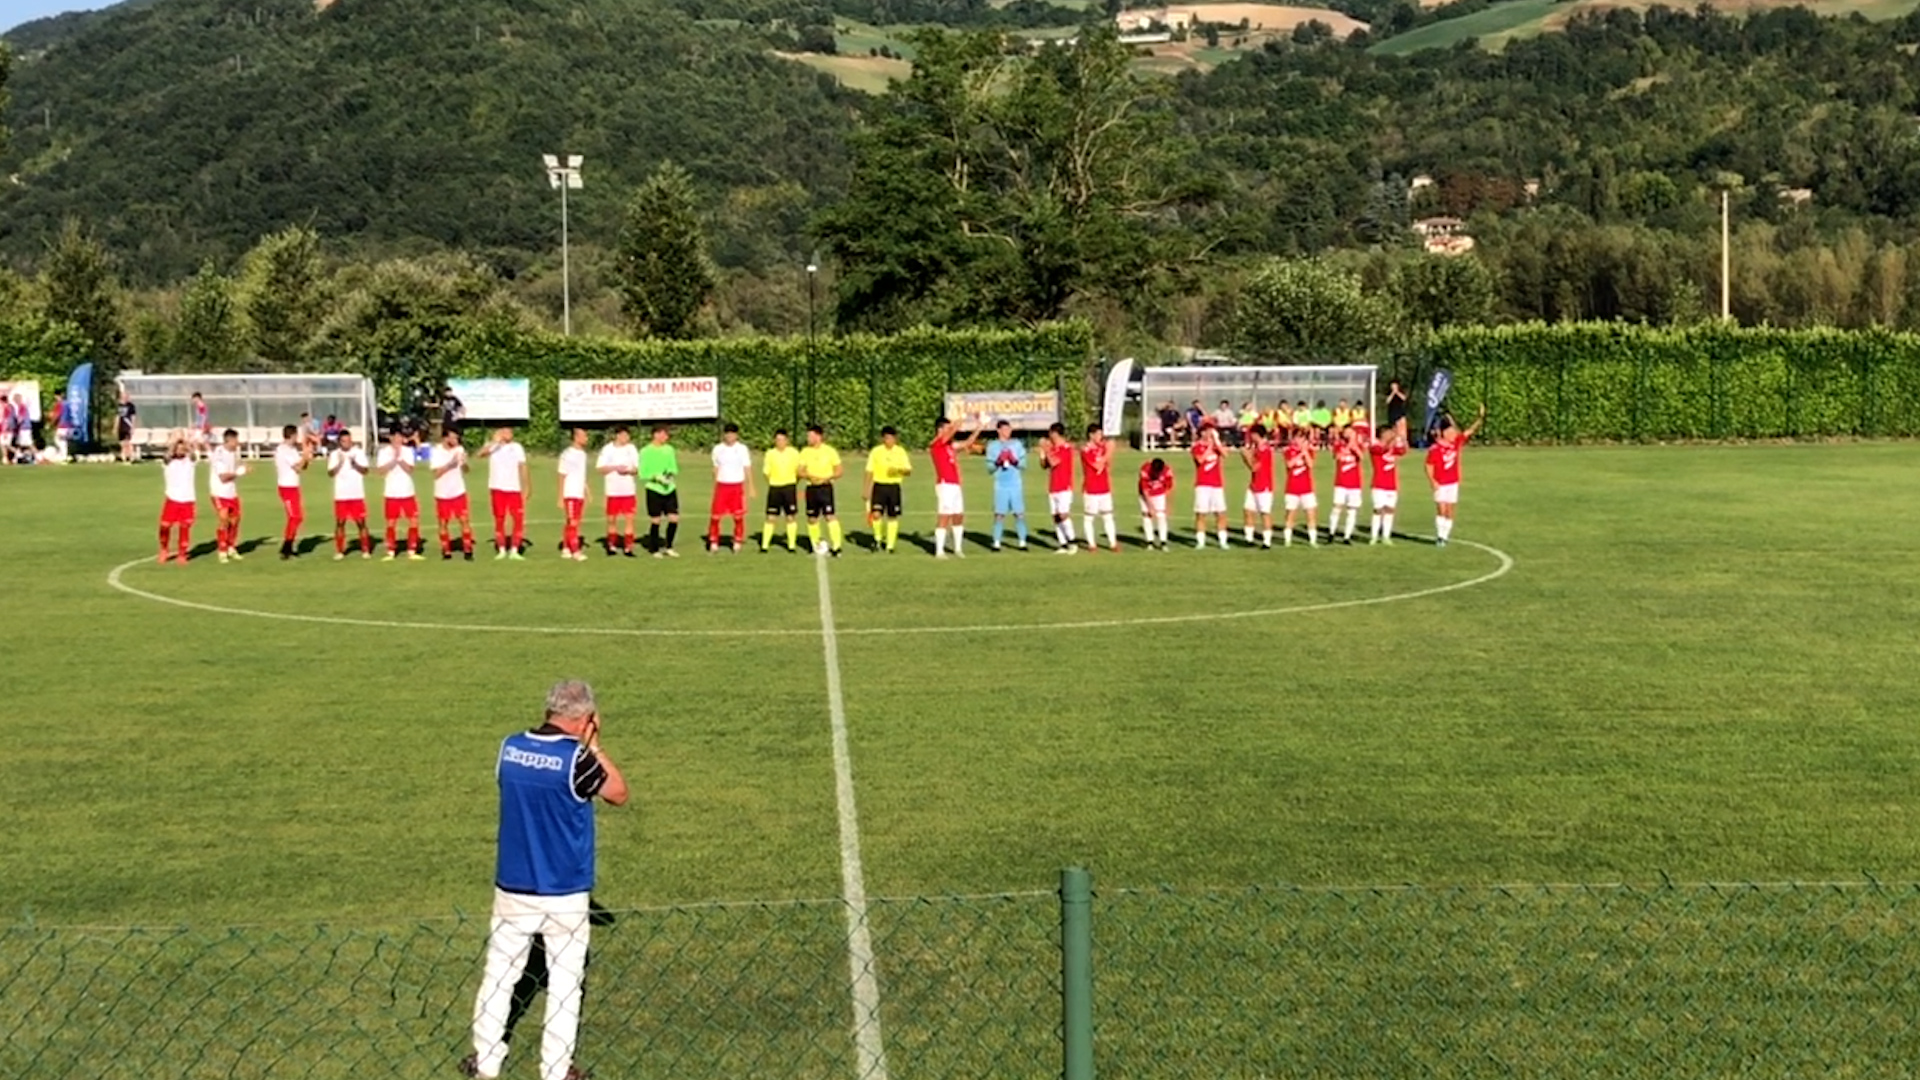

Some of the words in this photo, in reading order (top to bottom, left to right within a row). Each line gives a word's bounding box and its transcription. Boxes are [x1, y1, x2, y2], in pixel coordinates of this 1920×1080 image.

[591, 382, 665, 395] ANSELMI
[671, 380, 713, 393] MINO
[503, 746, 563, 770] Kappa
